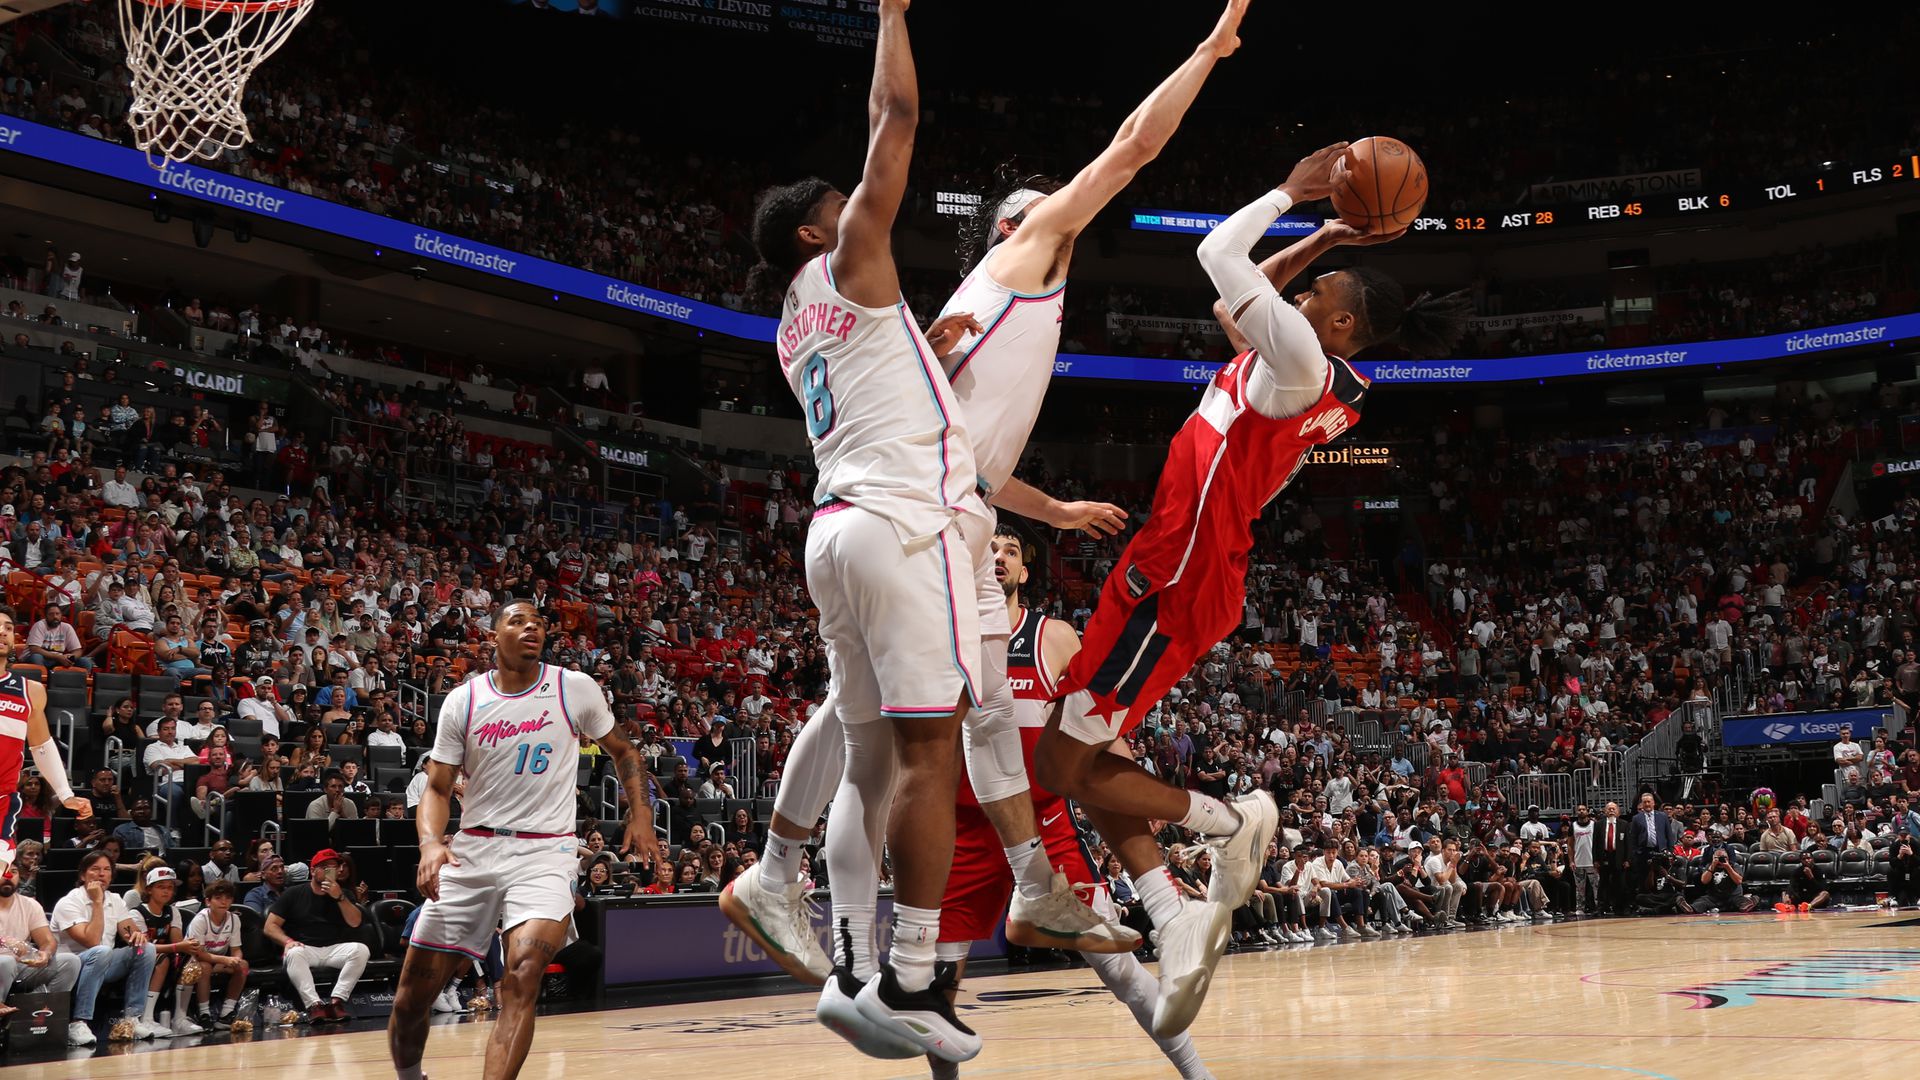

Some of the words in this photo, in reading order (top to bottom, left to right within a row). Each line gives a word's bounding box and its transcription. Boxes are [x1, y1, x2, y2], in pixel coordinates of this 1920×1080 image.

[634, 6, 696, 22] ACCIDENT
[699, 16, 769, 32] ATTORNEYS
[718, 0, 772, 17] LEVINE
[816, 24, 845, 37] TRUCK
[847, 29, 878, 40] ACCIDE
[843, 37, 865, 48] FALL
[159, 165, 286, 214] ticketmaster
[1414, 218, 1447, 231] 3P%
[1455, 217, 1486, 230] 31.2
[1501, 213, 1531, 228] AST
[1535, 212, 1554, 225] 28
[1588, 205, 1621, 220] REB
[1623, 203, 1643, 216] 45
[1678, 196, 1709, 212] BLK
[1719, 194, 1730, 207] 6
[1765, 184, 1797, 200] TOL
[1816, 178, 1825, 191] 1
[1852, 167, 1883, 185] FLS
[1892, 164, 1903, 177] 2
[1134, 213, 1161, 225] WATCH
[1161, 215, 1176, 227] THE
[1176, 217, 1195, 228] HEAT
[1195, 218, 1207, 229] ON
[1280, 221, 1316, 229] NETWORK
[413, 232, 518, 275] ticketmaster
[606, 283, 693, 320] ticketmaster
[1488, 319, 1500, 328] US
[1502, 318, 1513, 327] AT
[1785, 325, 1886, 352] ticketmaster
[1586, 350, 1687, 370] ticketmaster
[1374, 364, 1473, 380] ticketmaster
[801, 351, 838, 441] 8
[600, 446, 650, 467] BACARDÍ
[1353, 447, 1390, 456] OCHO
[1364, 498, 1399, 509] BACARDÍ
[473, 710, 554, 748] Miami
[514, 742, 553, 775] 16
